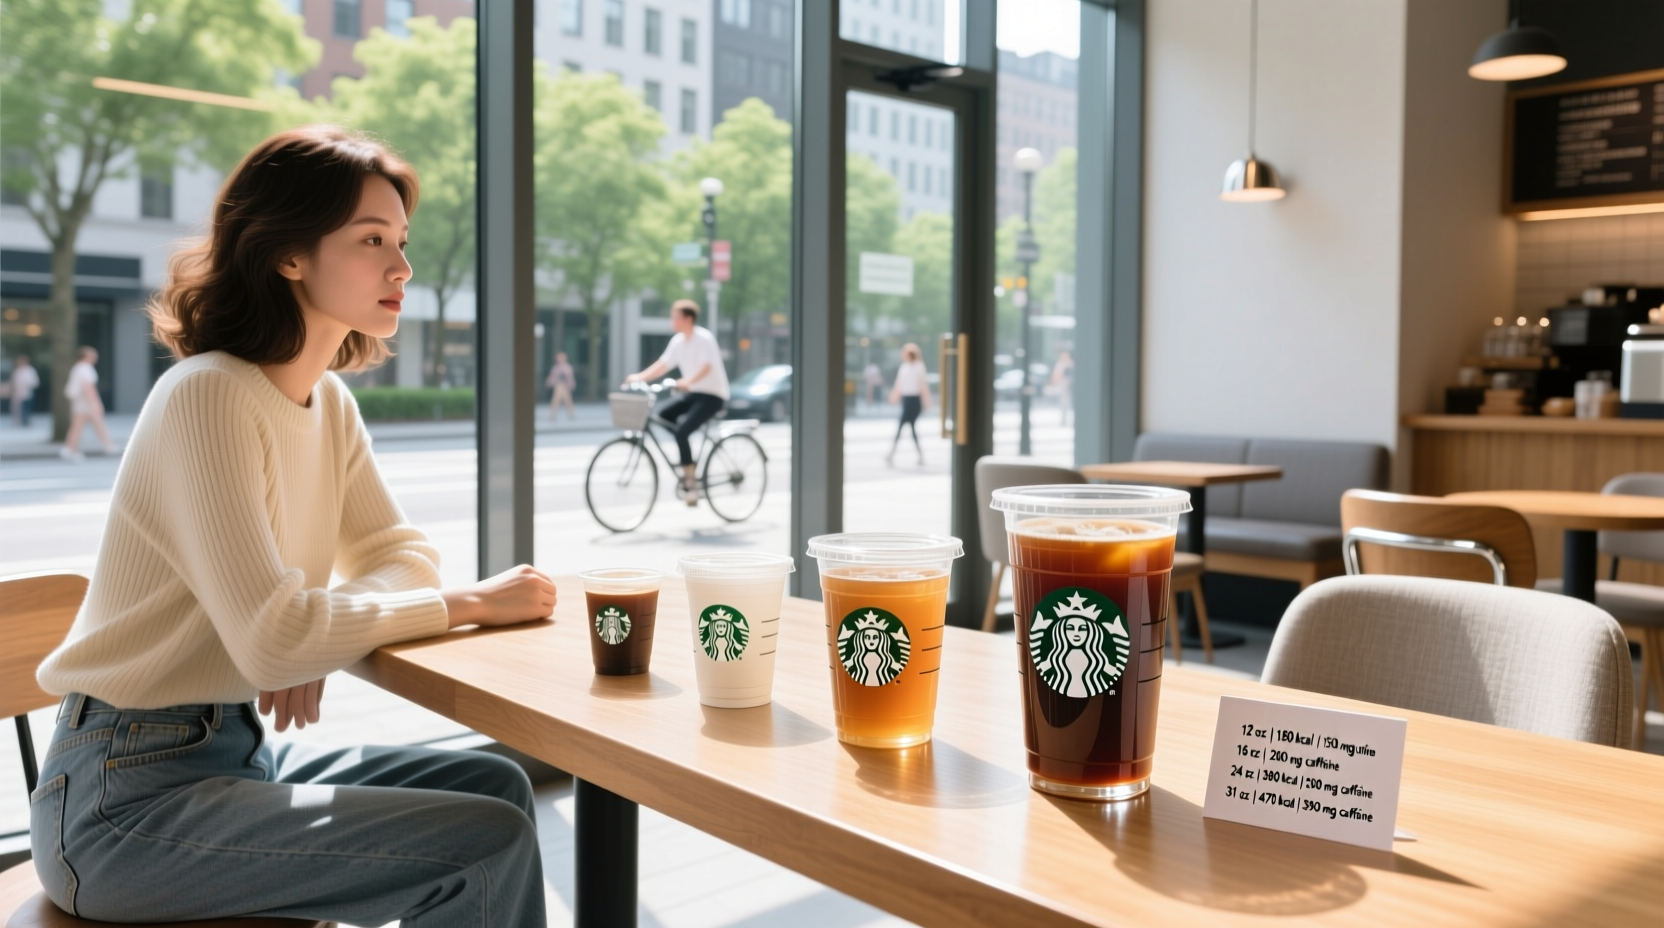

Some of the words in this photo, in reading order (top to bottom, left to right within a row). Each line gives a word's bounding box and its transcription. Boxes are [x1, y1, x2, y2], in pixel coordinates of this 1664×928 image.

[1242, 724, 1253, 737] 12
[1237, 744, 1248, 756] 16
[1230, 764, 1243, 777] 24
[1225, 785, 1237, 799] 31
[1258, 792, 1277, 805] 470
[1322, 805, 1337, 820] mg
